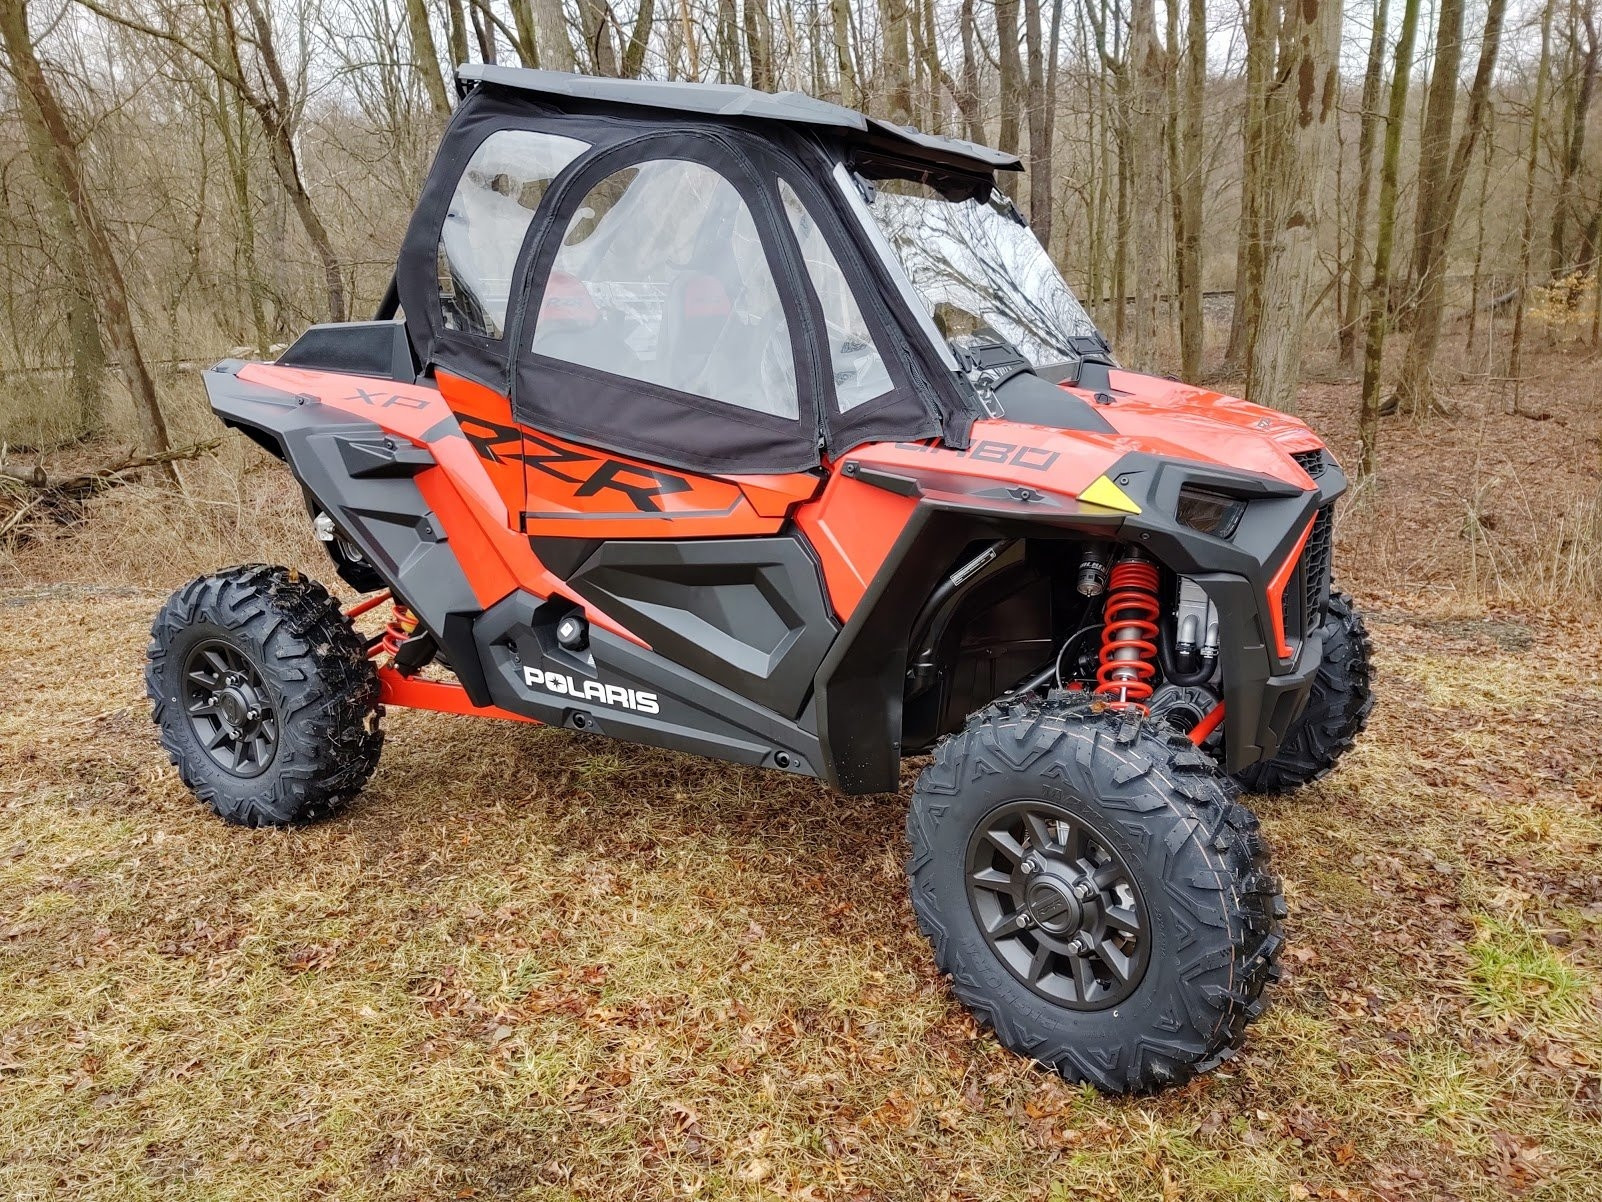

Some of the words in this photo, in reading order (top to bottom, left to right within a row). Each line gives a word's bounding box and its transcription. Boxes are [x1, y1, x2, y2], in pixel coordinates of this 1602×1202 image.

[343, 387, 431, 410] XP
[452, 410, 694, 519] RZR
[893, 437, 1061, 471] UBO
[523, 665, 660, 714] POLARIS
